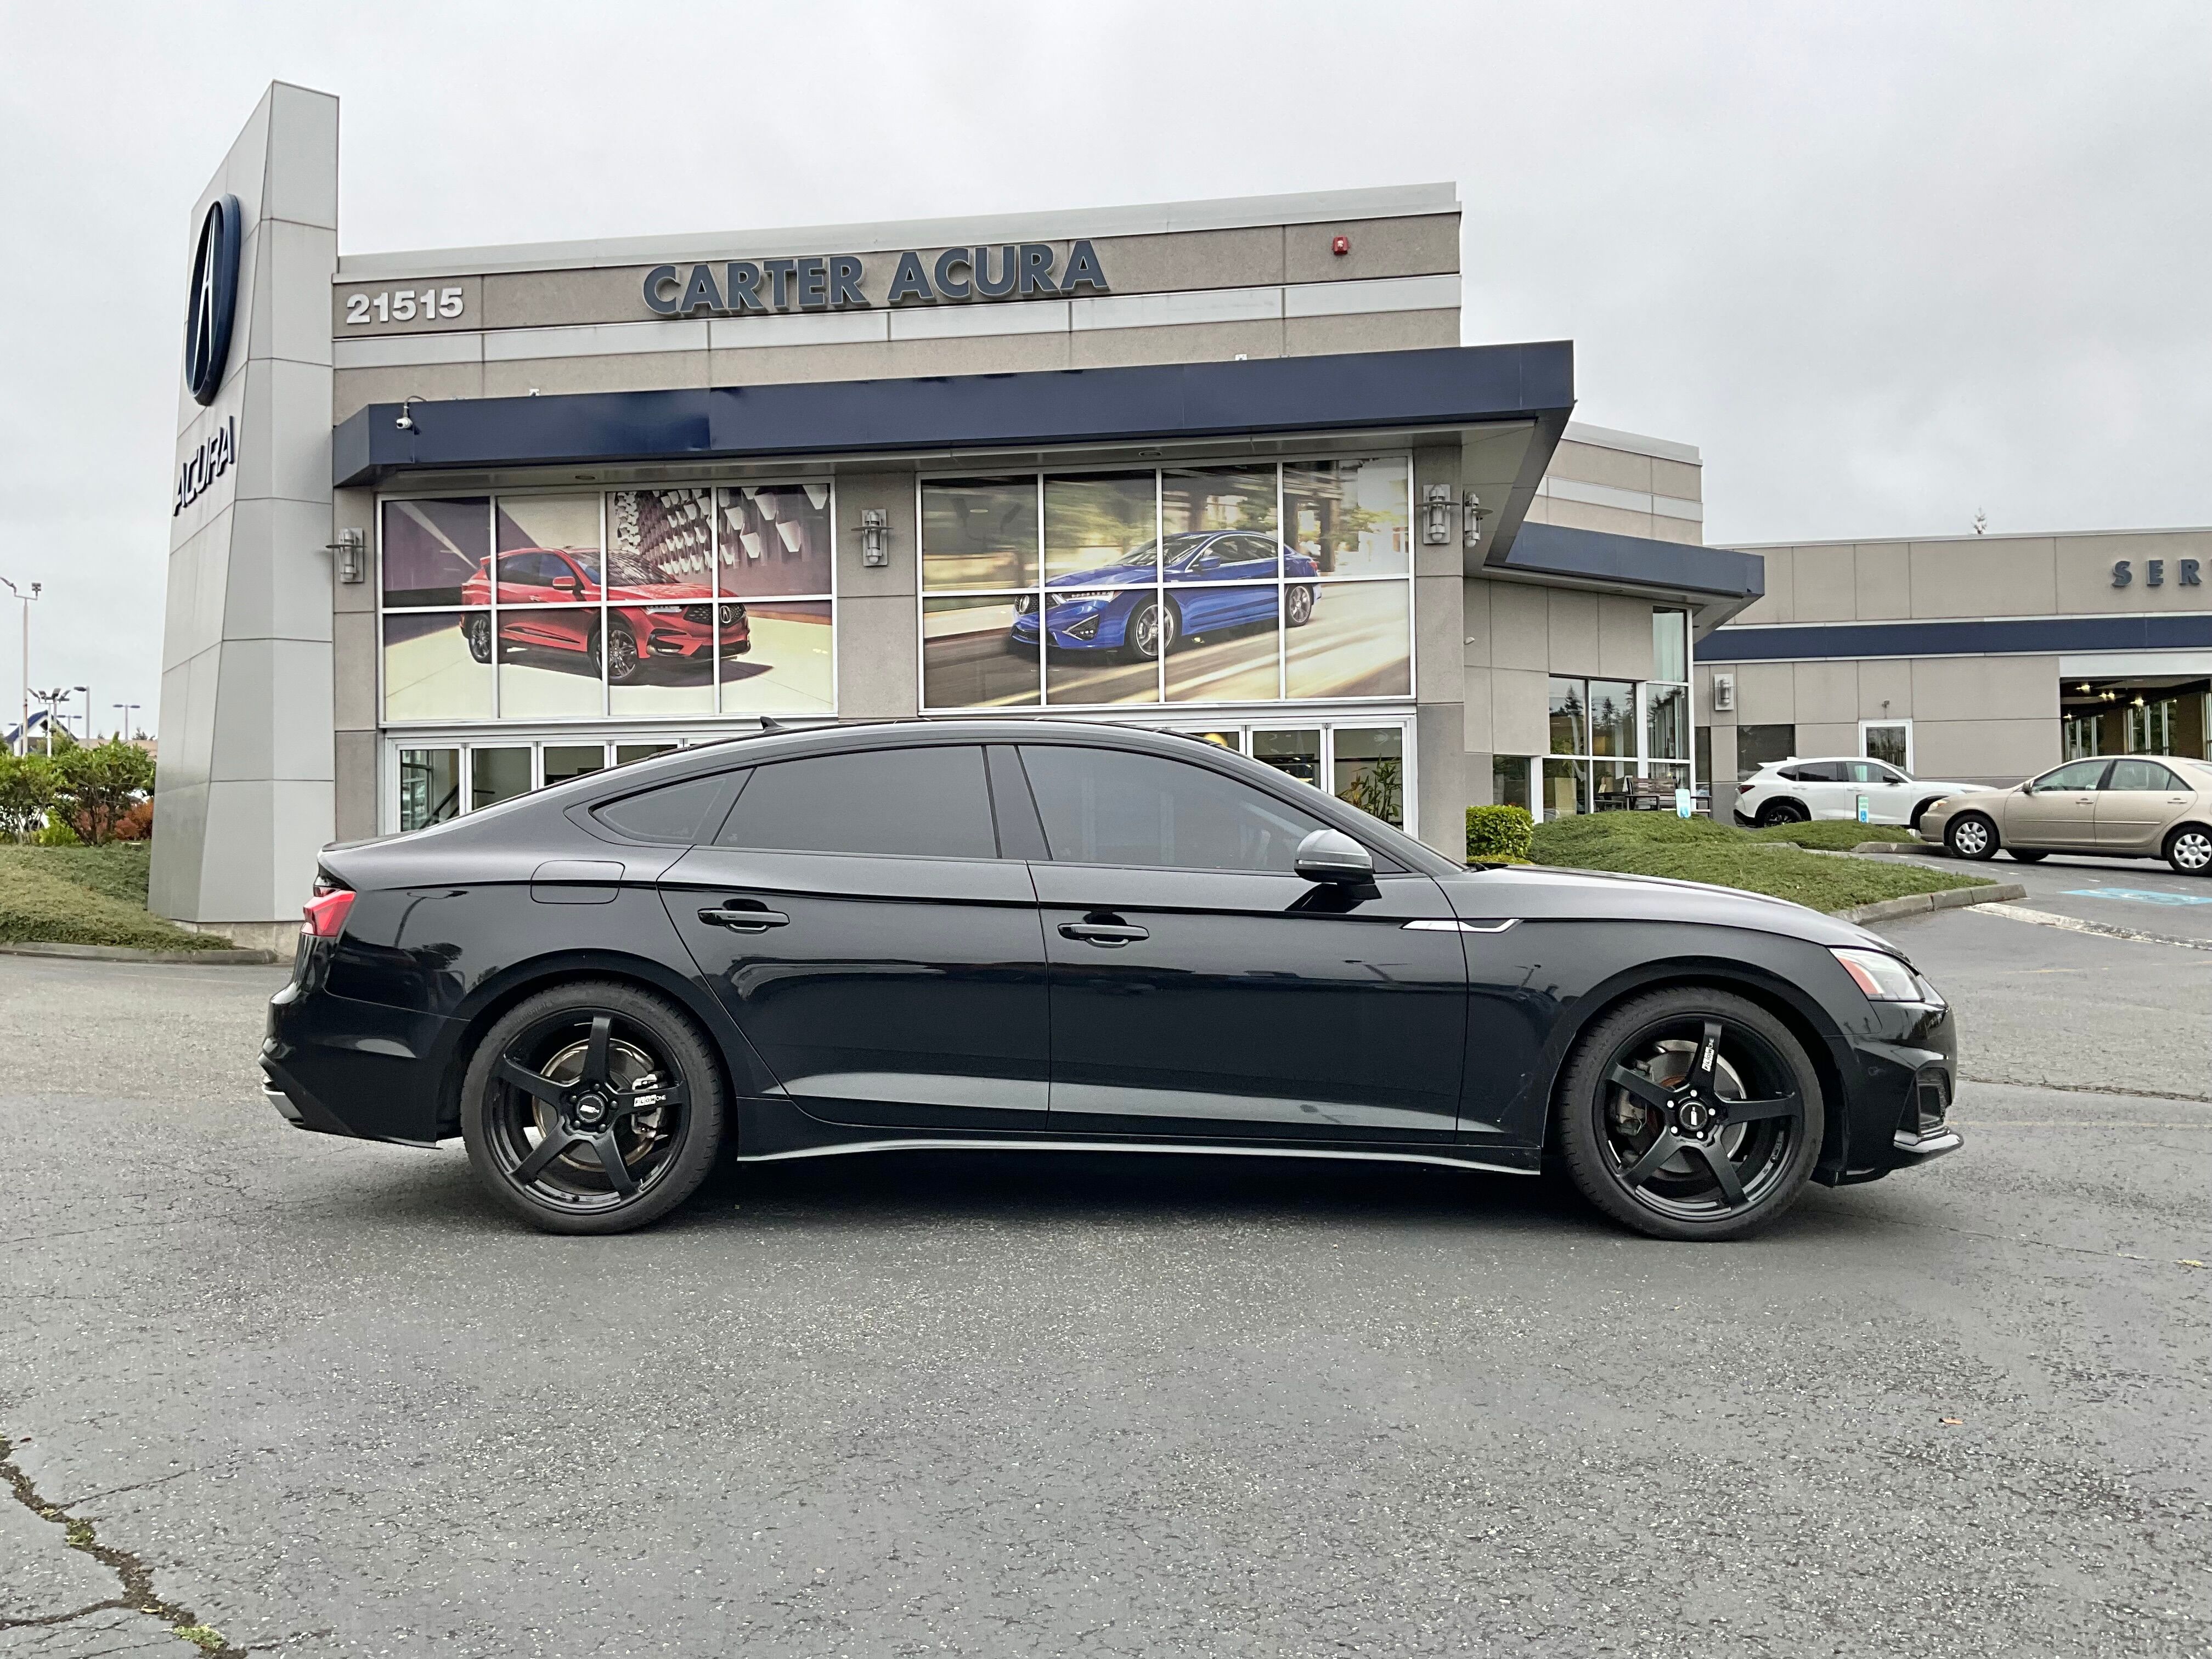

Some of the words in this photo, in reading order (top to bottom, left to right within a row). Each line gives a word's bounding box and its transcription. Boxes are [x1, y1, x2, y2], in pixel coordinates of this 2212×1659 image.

[643, 256, 870, 314] CARTER
[887, 240, 1110, 302] ACURA
[347, 287, 464, 324] 21515
[173, 415, 234, 517] ACURA
[2112, 558, 2212, 586] SER
